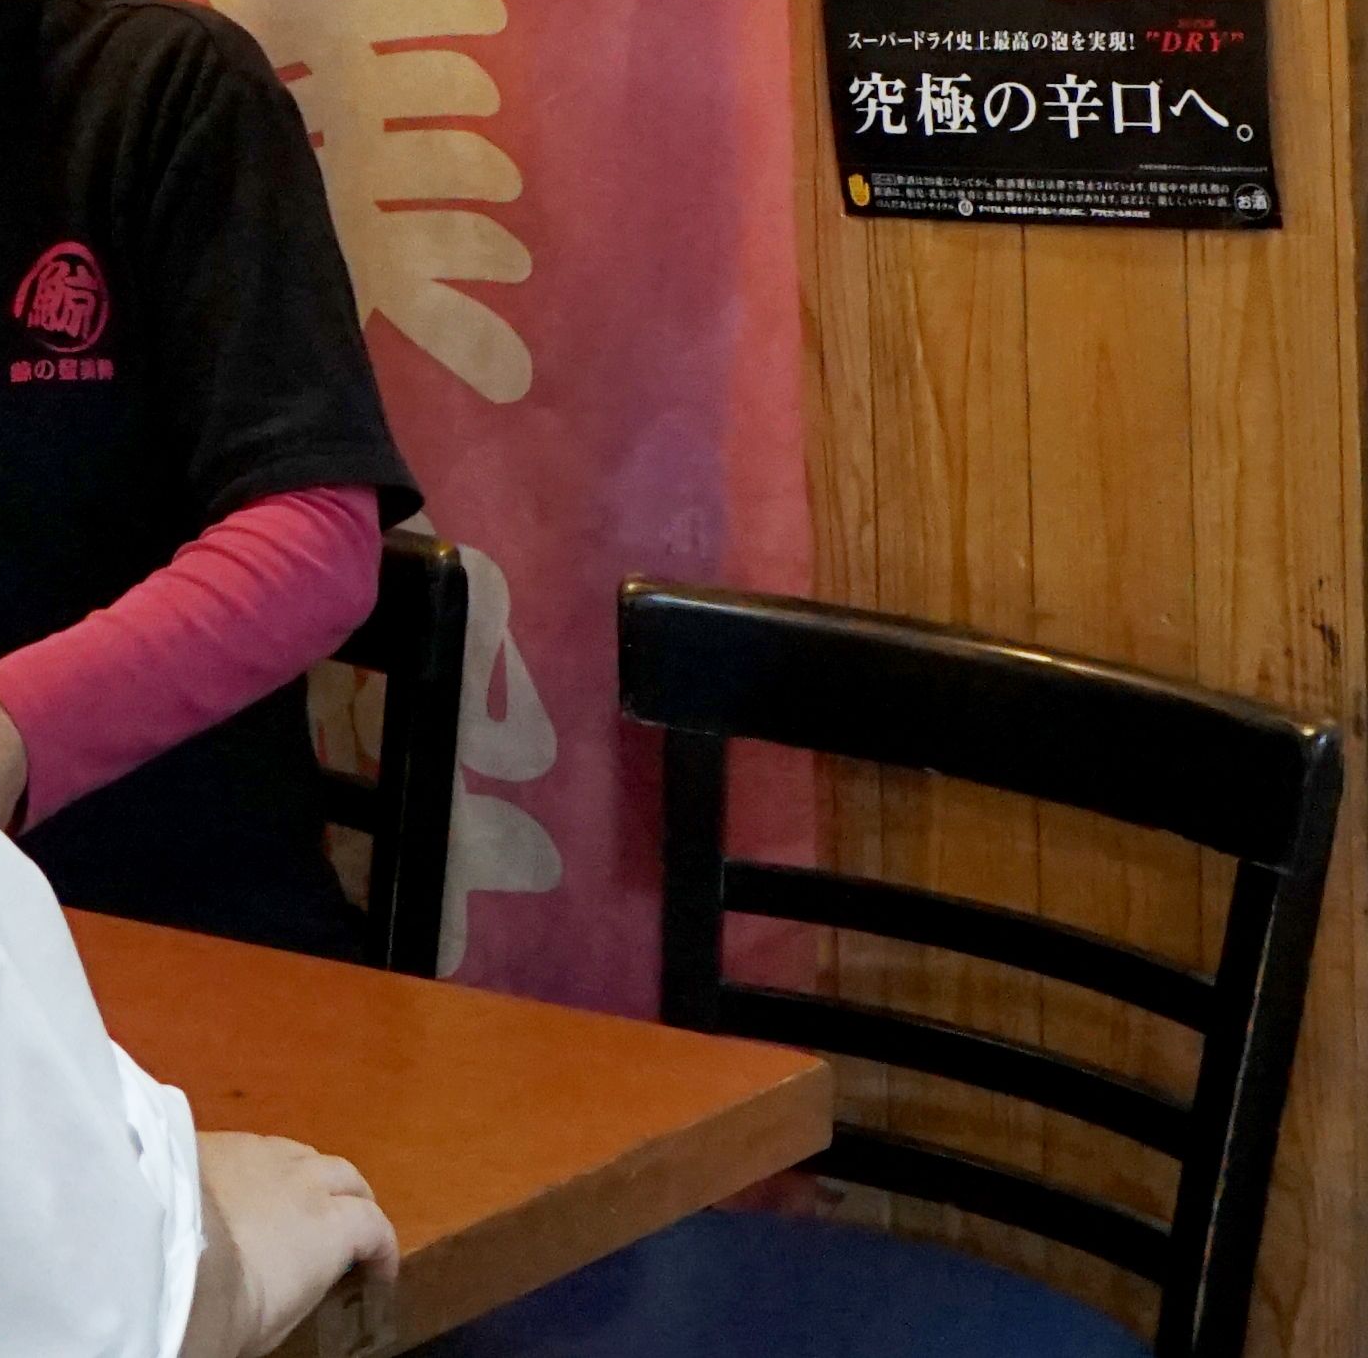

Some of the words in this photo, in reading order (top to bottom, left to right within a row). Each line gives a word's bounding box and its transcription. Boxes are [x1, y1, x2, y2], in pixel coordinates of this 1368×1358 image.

[848, 29, 1136, 52] スーパードライ史上最高の泡を実現！
[848, 71, 1254, 143] 究極の辛口へ。
